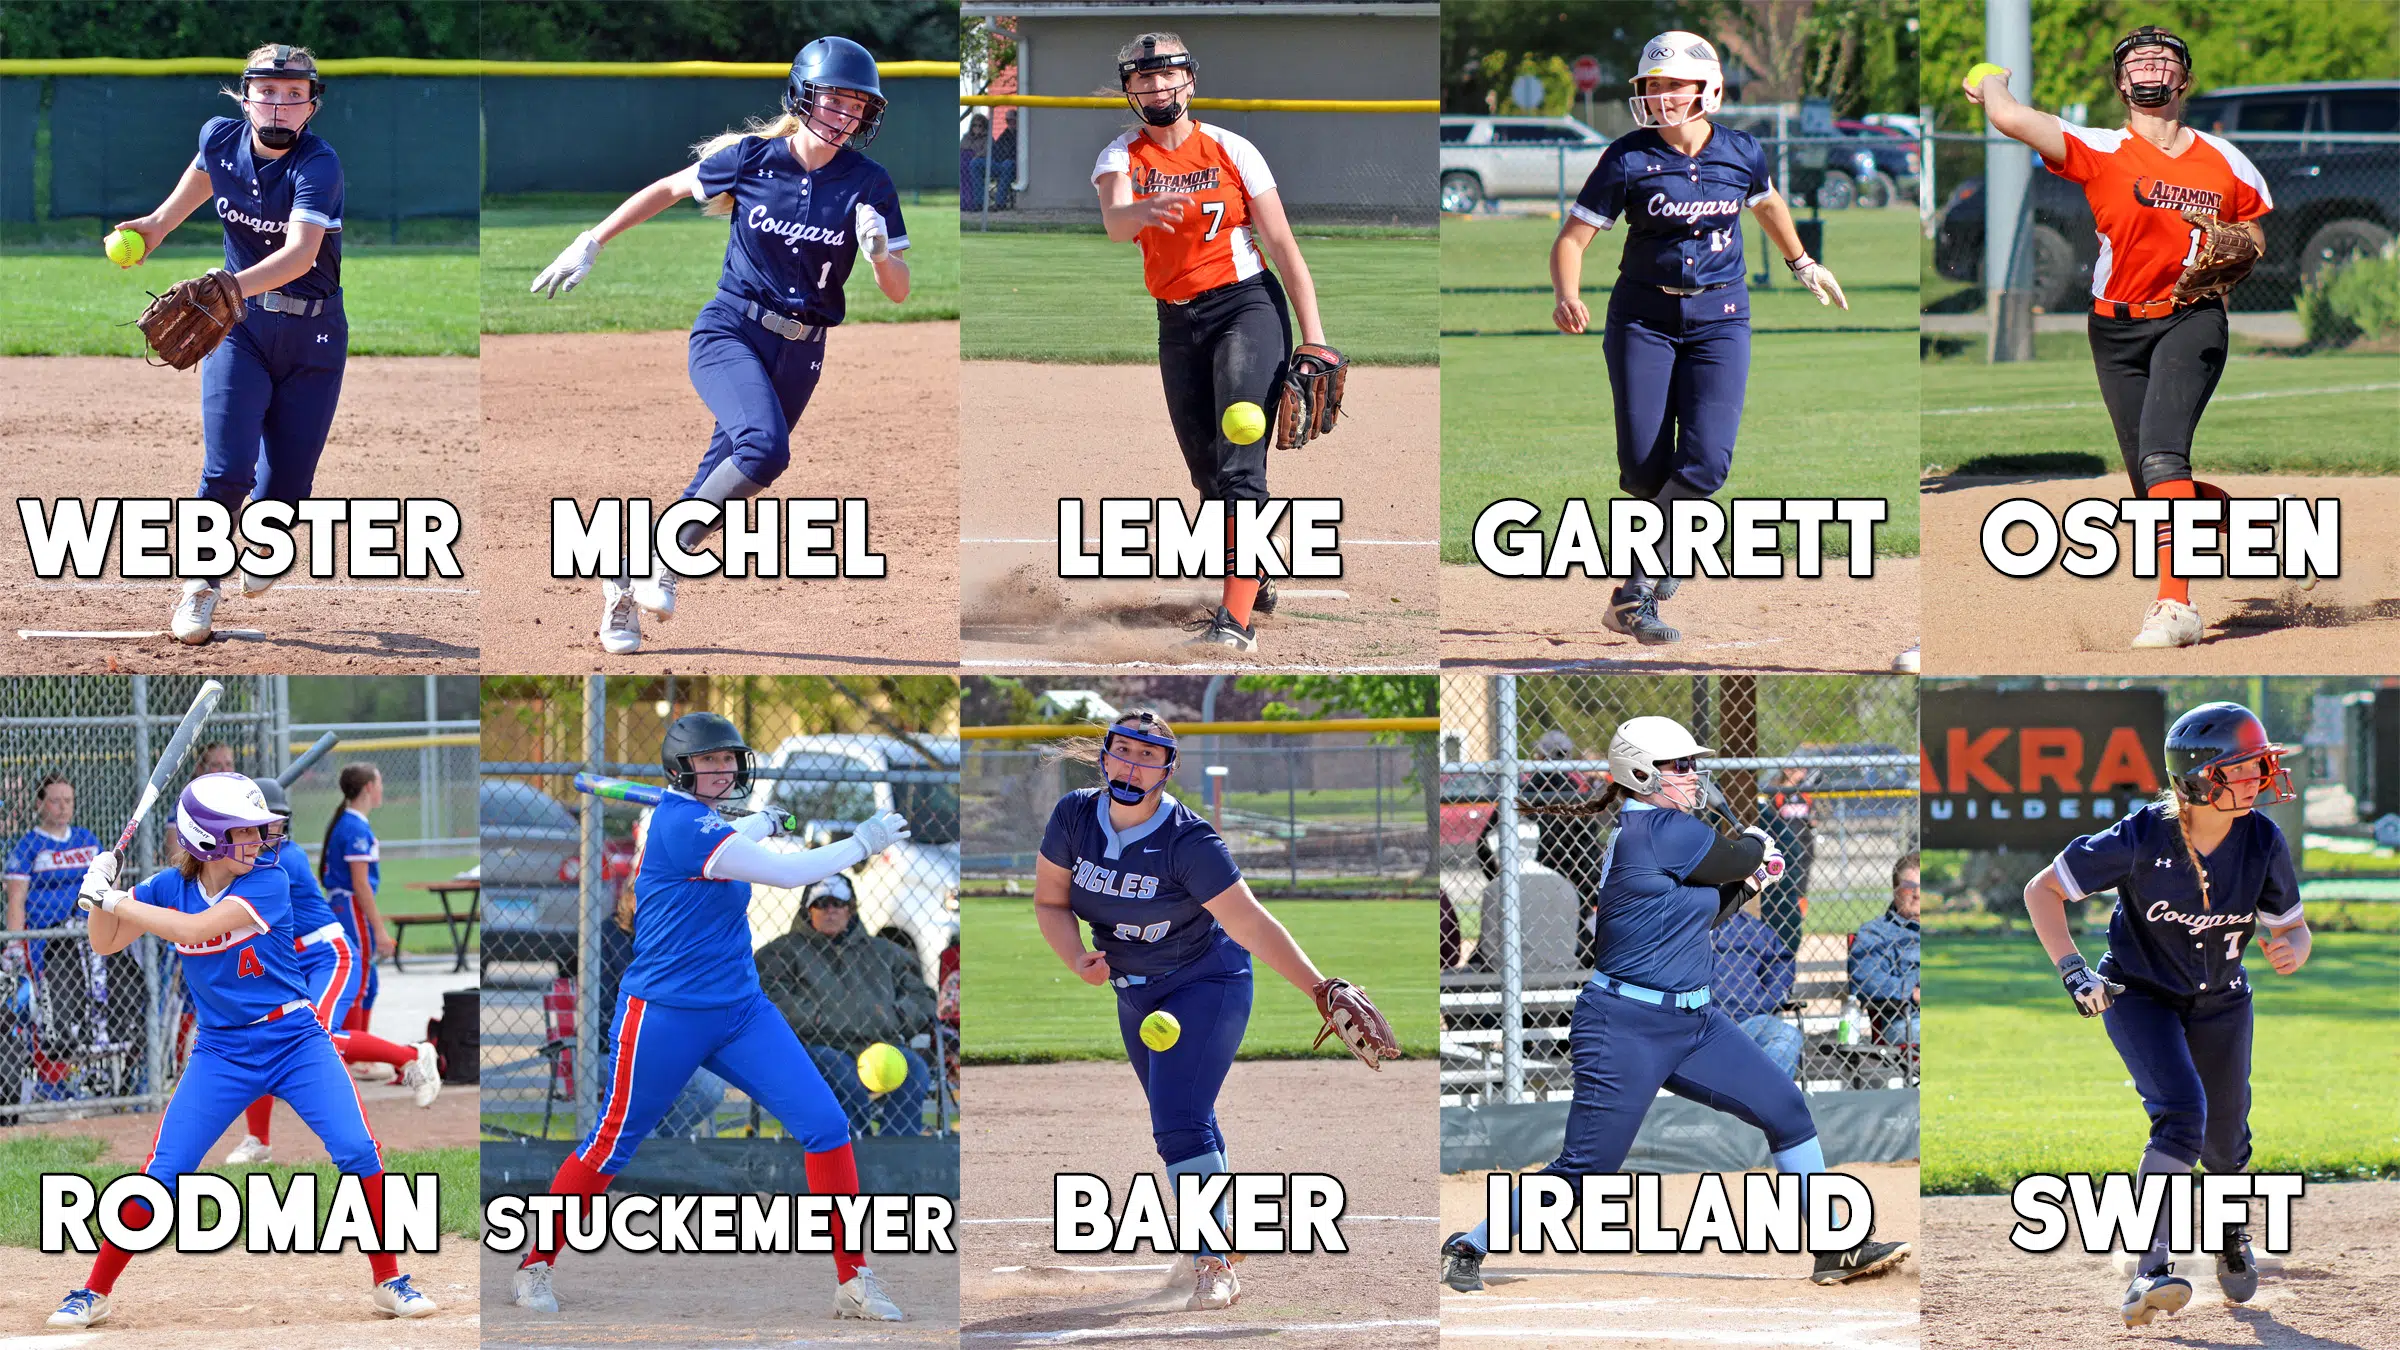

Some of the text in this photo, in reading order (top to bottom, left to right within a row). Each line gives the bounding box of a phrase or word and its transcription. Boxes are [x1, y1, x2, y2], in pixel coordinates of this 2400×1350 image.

[1144, 167, 1220, 189] ALTAMONT
[1647, 192, 1739, 225] Cougars
[2148, 180, 2223, 208] ALTAMONT
[2153, 199, 2178, 208] LADY
[216, 197, 290, 234] Cougar
[748, 204, 845, 246] Cougars
[1202, 201, 1225, 242] 7
[817, 260, 833, 290] 1
[1930, 799, 2149, 820] UILDER
[2146, 900, 2254, 935] Cougars
[2224, 930, 2244, 960] 7
[237, 945, 265, 979] 4
